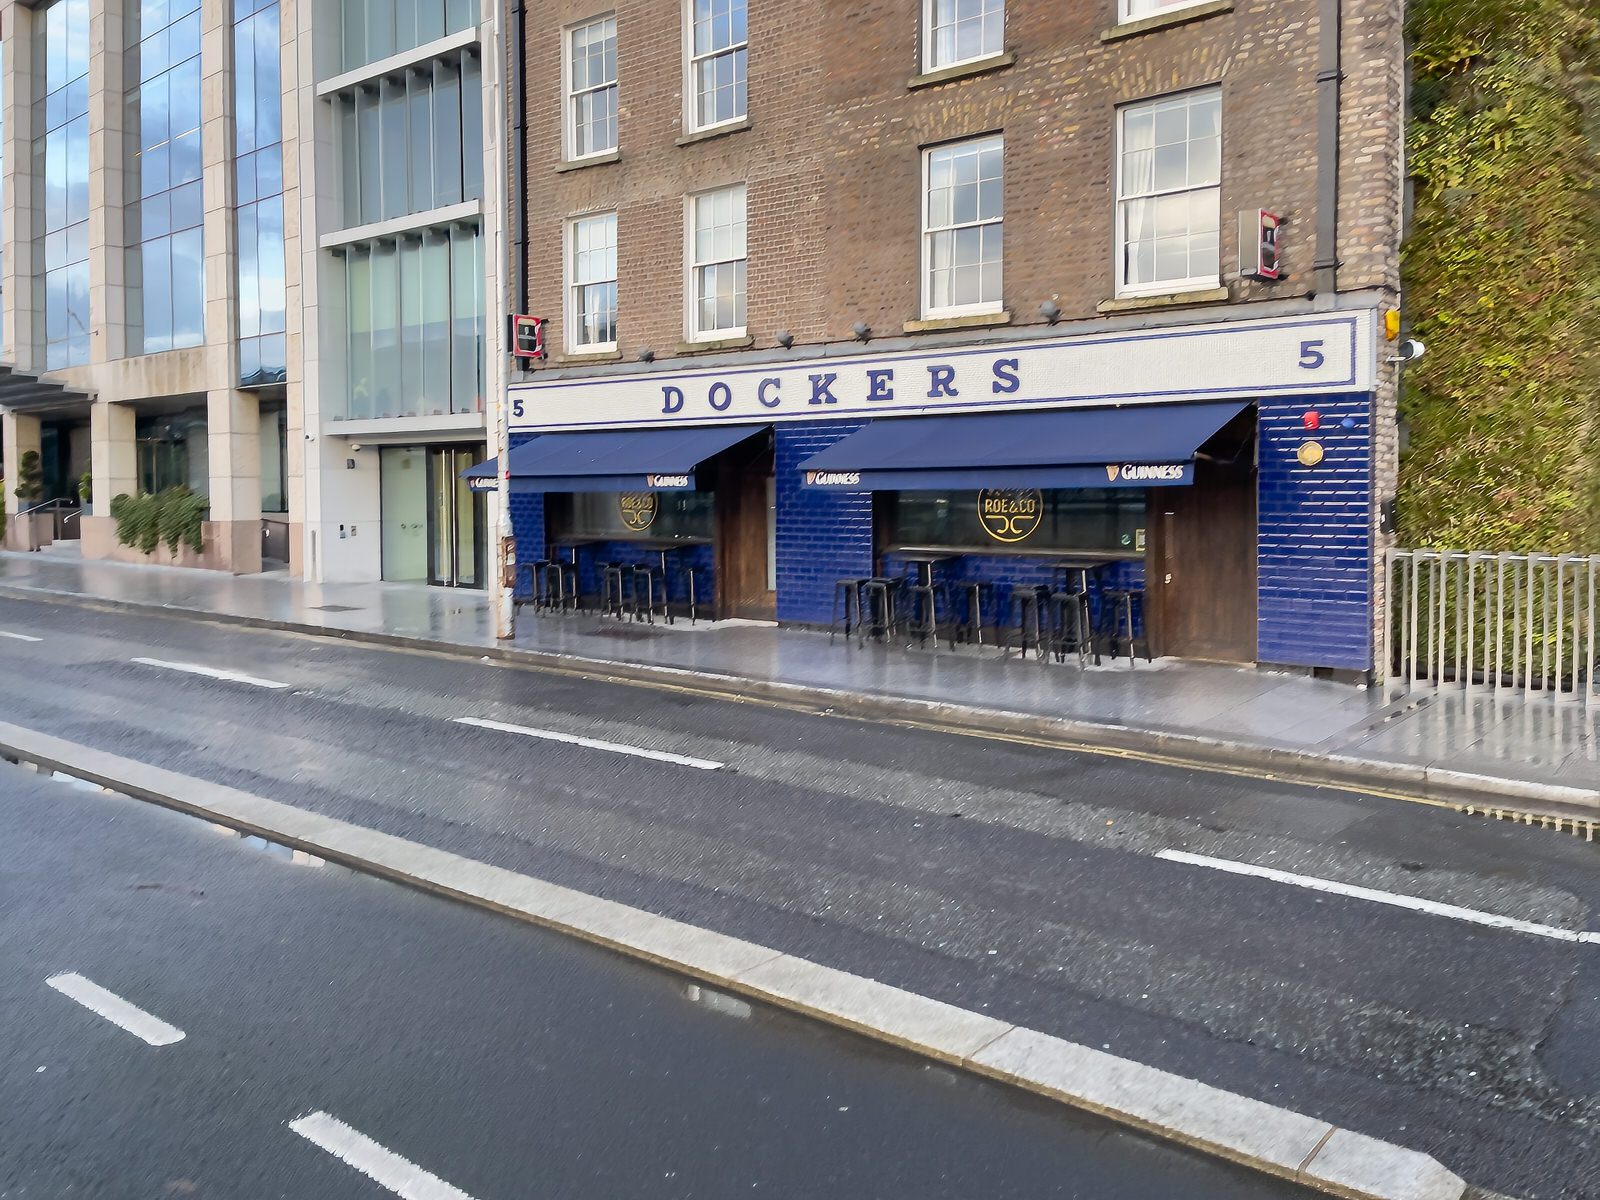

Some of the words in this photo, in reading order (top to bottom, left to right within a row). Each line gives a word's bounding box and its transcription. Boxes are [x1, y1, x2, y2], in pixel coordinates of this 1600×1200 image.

[513, 399, 524, 418] 5
[661, 358, 1020, 414] DOCKERS
[1298, 339, 1325, 370] 5
[815, 471, 861, 485] GUINNESS
[1121, 464, 1184, 480] GUINNESS
